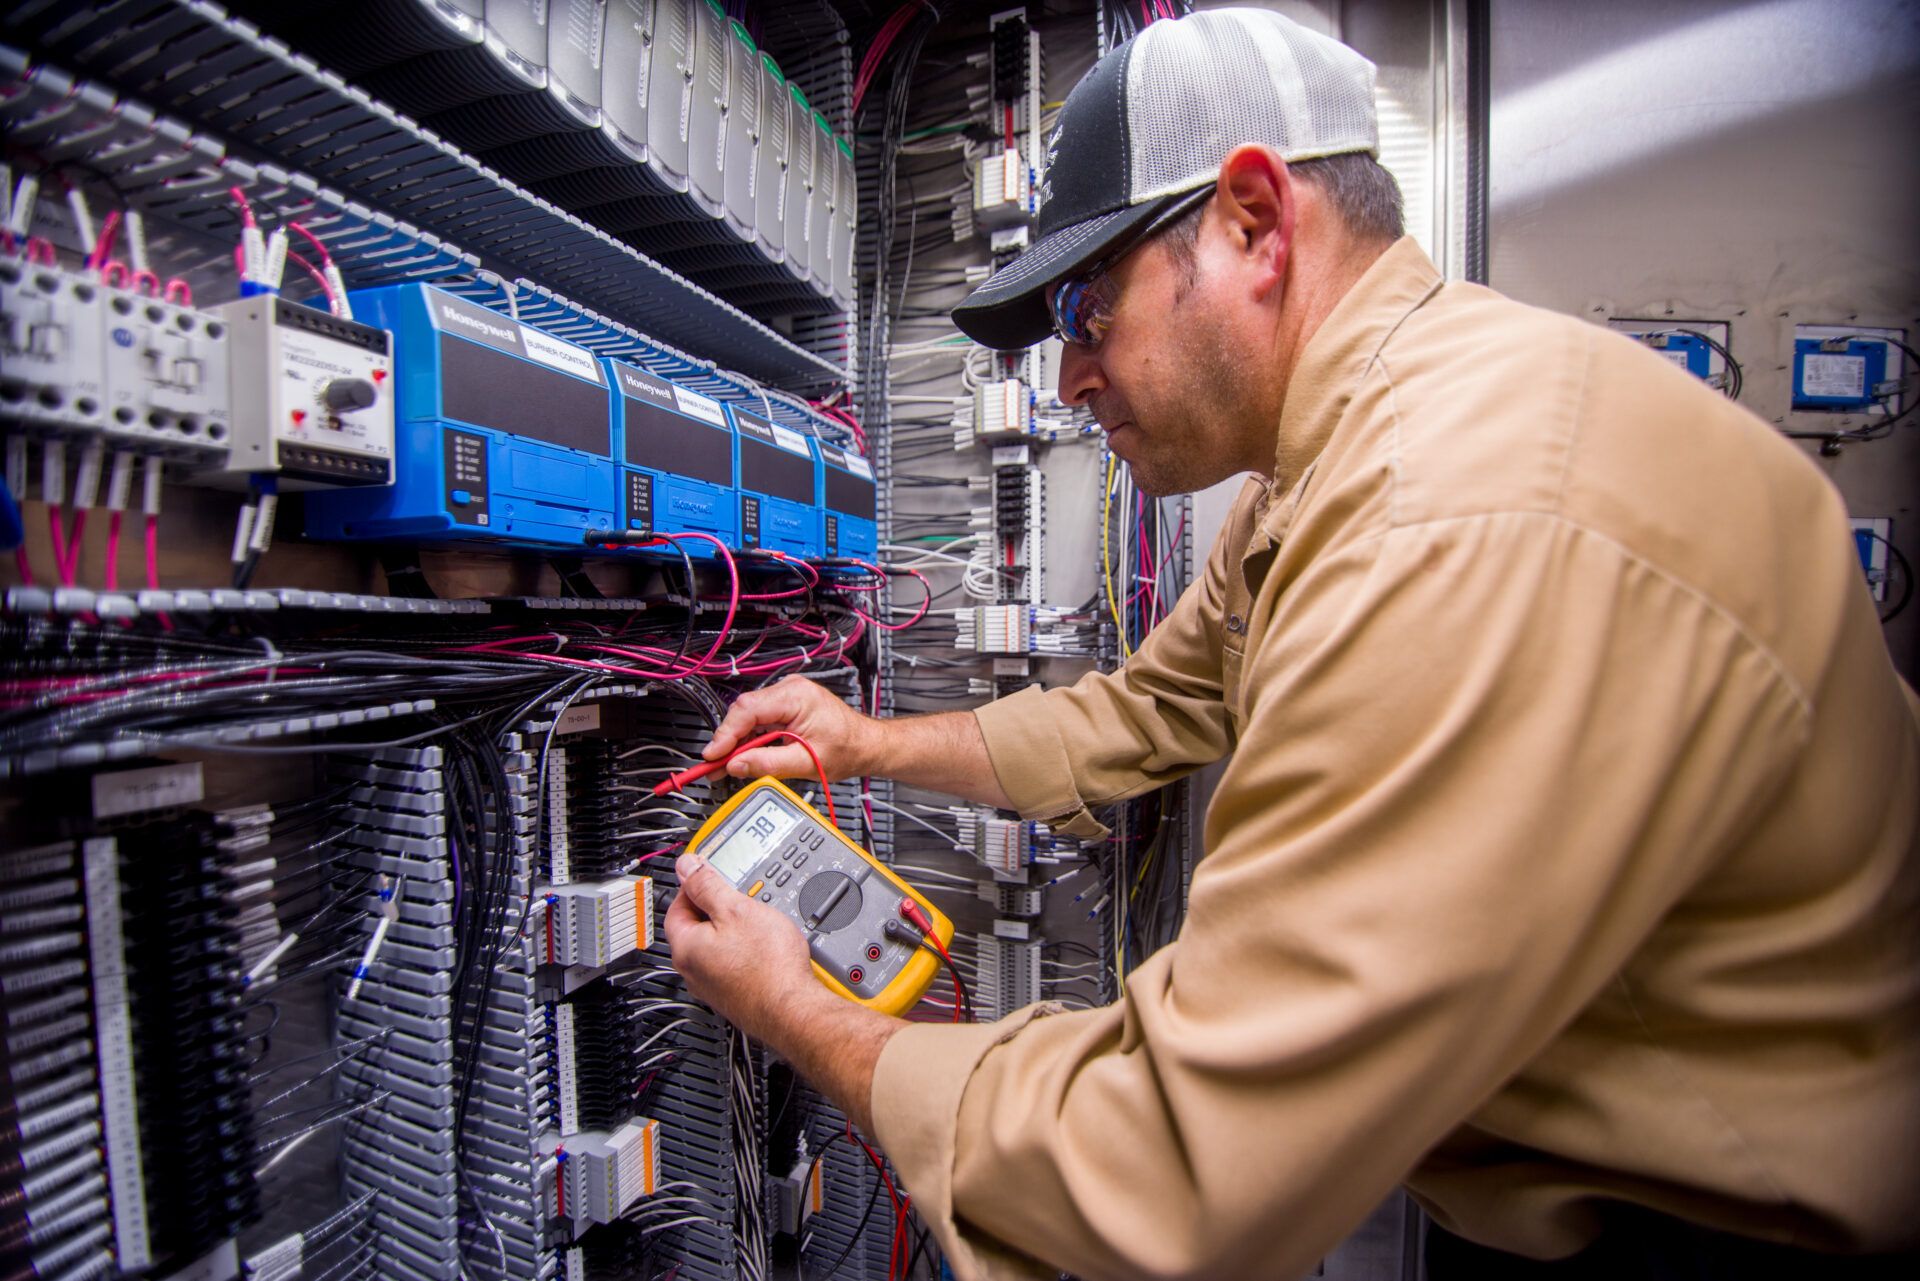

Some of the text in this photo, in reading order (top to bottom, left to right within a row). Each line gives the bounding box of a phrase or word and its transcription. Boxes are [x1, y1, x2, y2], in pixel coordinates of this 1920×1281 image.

[442, 304, 517, 343] Honeywell
[526, 338, 594, 371] BURNER CONTROL
[625, 373, 672, 400] Honeywell
[672, 495, 713, 515] Honeywell
